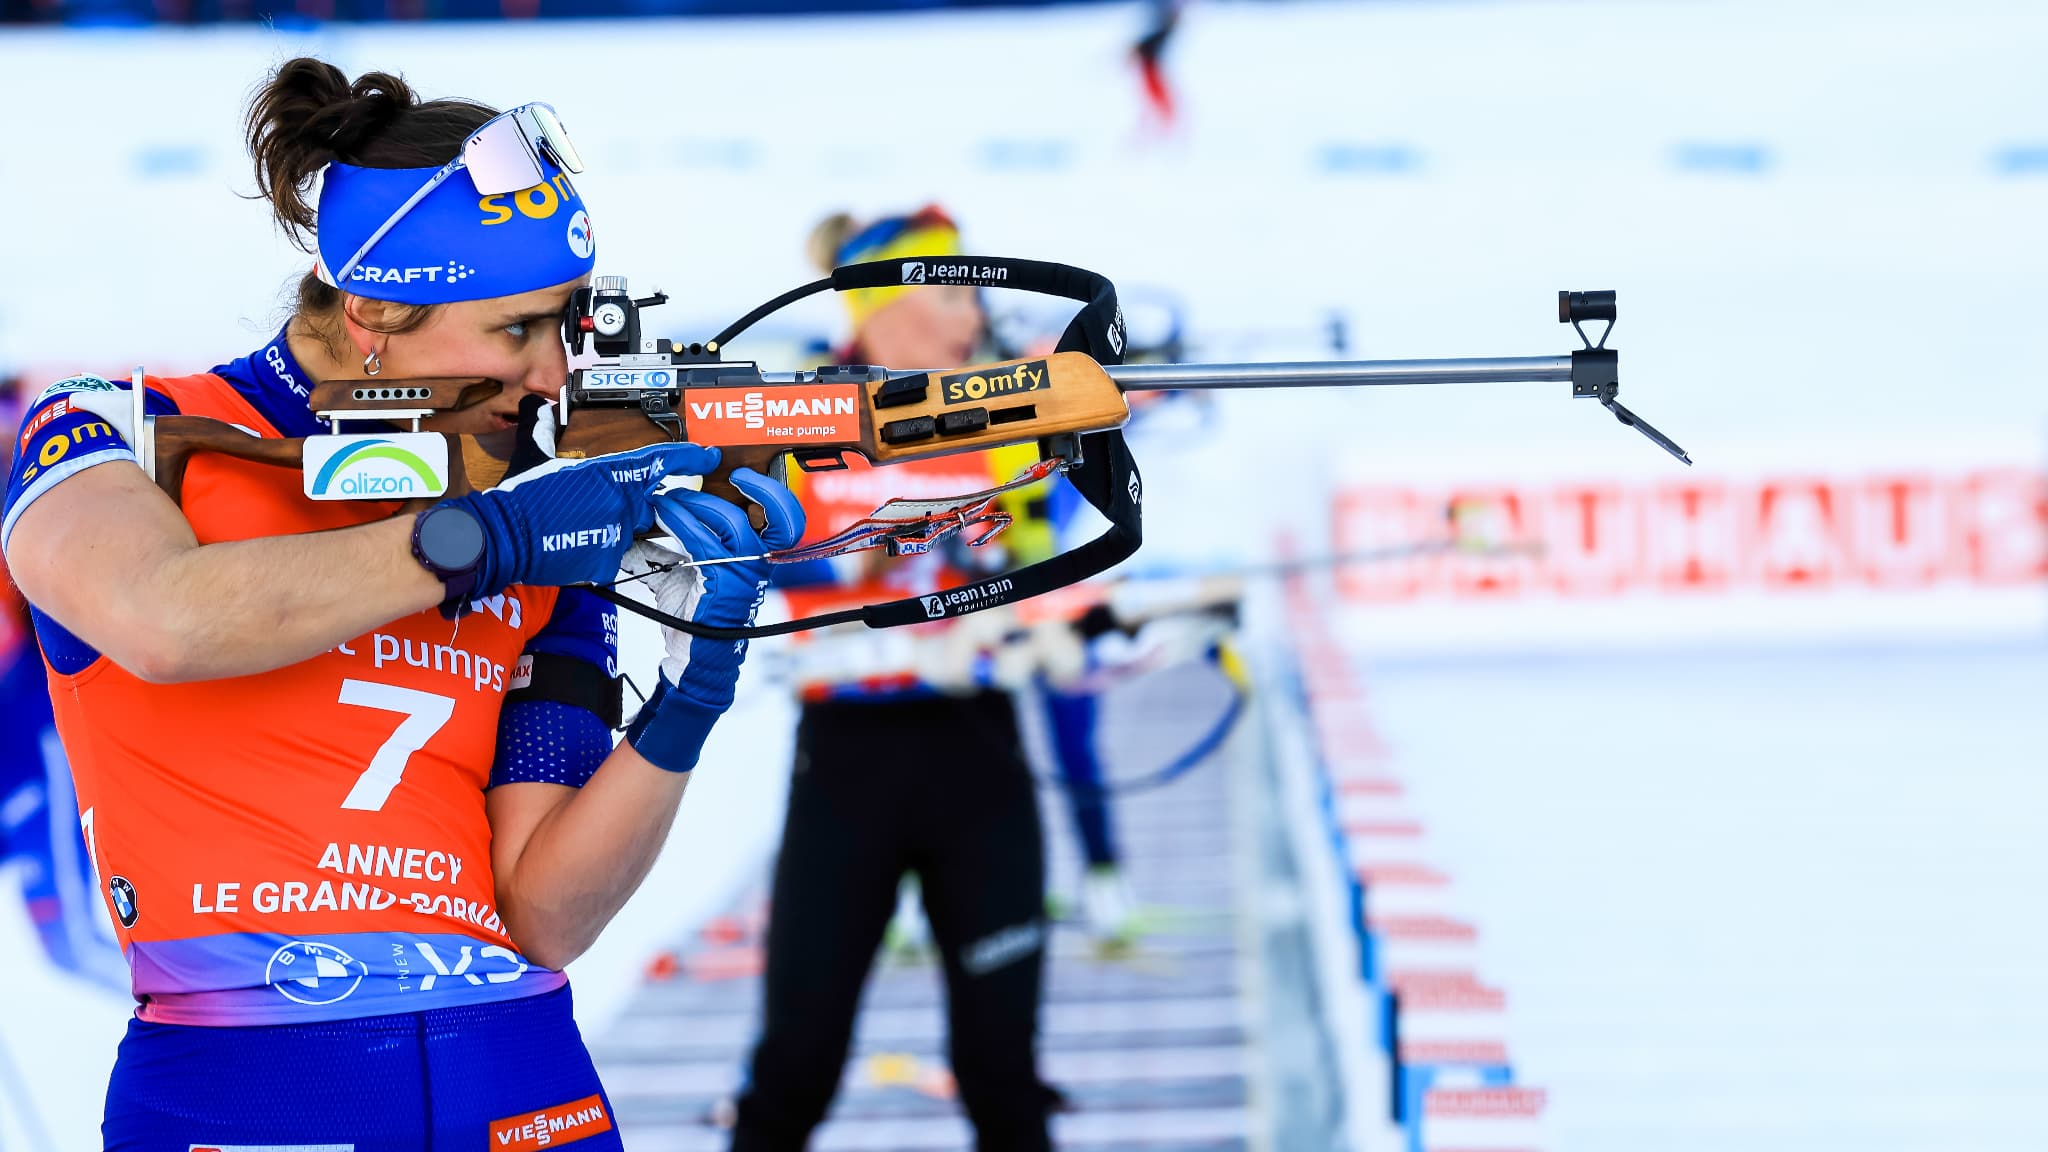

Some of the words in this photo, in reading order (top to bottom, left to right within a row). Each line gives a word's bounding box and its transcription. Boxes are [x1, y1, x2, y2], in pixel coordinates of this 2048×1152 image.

[479, 173, 576, 225] som
[351, 265, 443, 284] CRAFT
[928, 264, 969, 278] Jean
[972, 265, 1008, 280] Lain
[265, 346, 310, 400] CRAF
[949, 364, 1043, 400] somfy
[690, 392, 854, 429] VIESSMANN
[767, 426, 793, 437] Heat
[797, 425, 836, 438] pumps
[22, 422, 124, 487] som
[340, 472, 413, 495] alizon
[945, 587, 979, 607] Jean
[979, 578, 1013, 597] Lain
[373, 632, 505, 693] pumps
[337, 678, 456, 812] 7
[317, 842, 462, 885] ANNECY
[192, 882, 241, 914] LE
[497, 1106, 602, 1147] VIESSMANN
